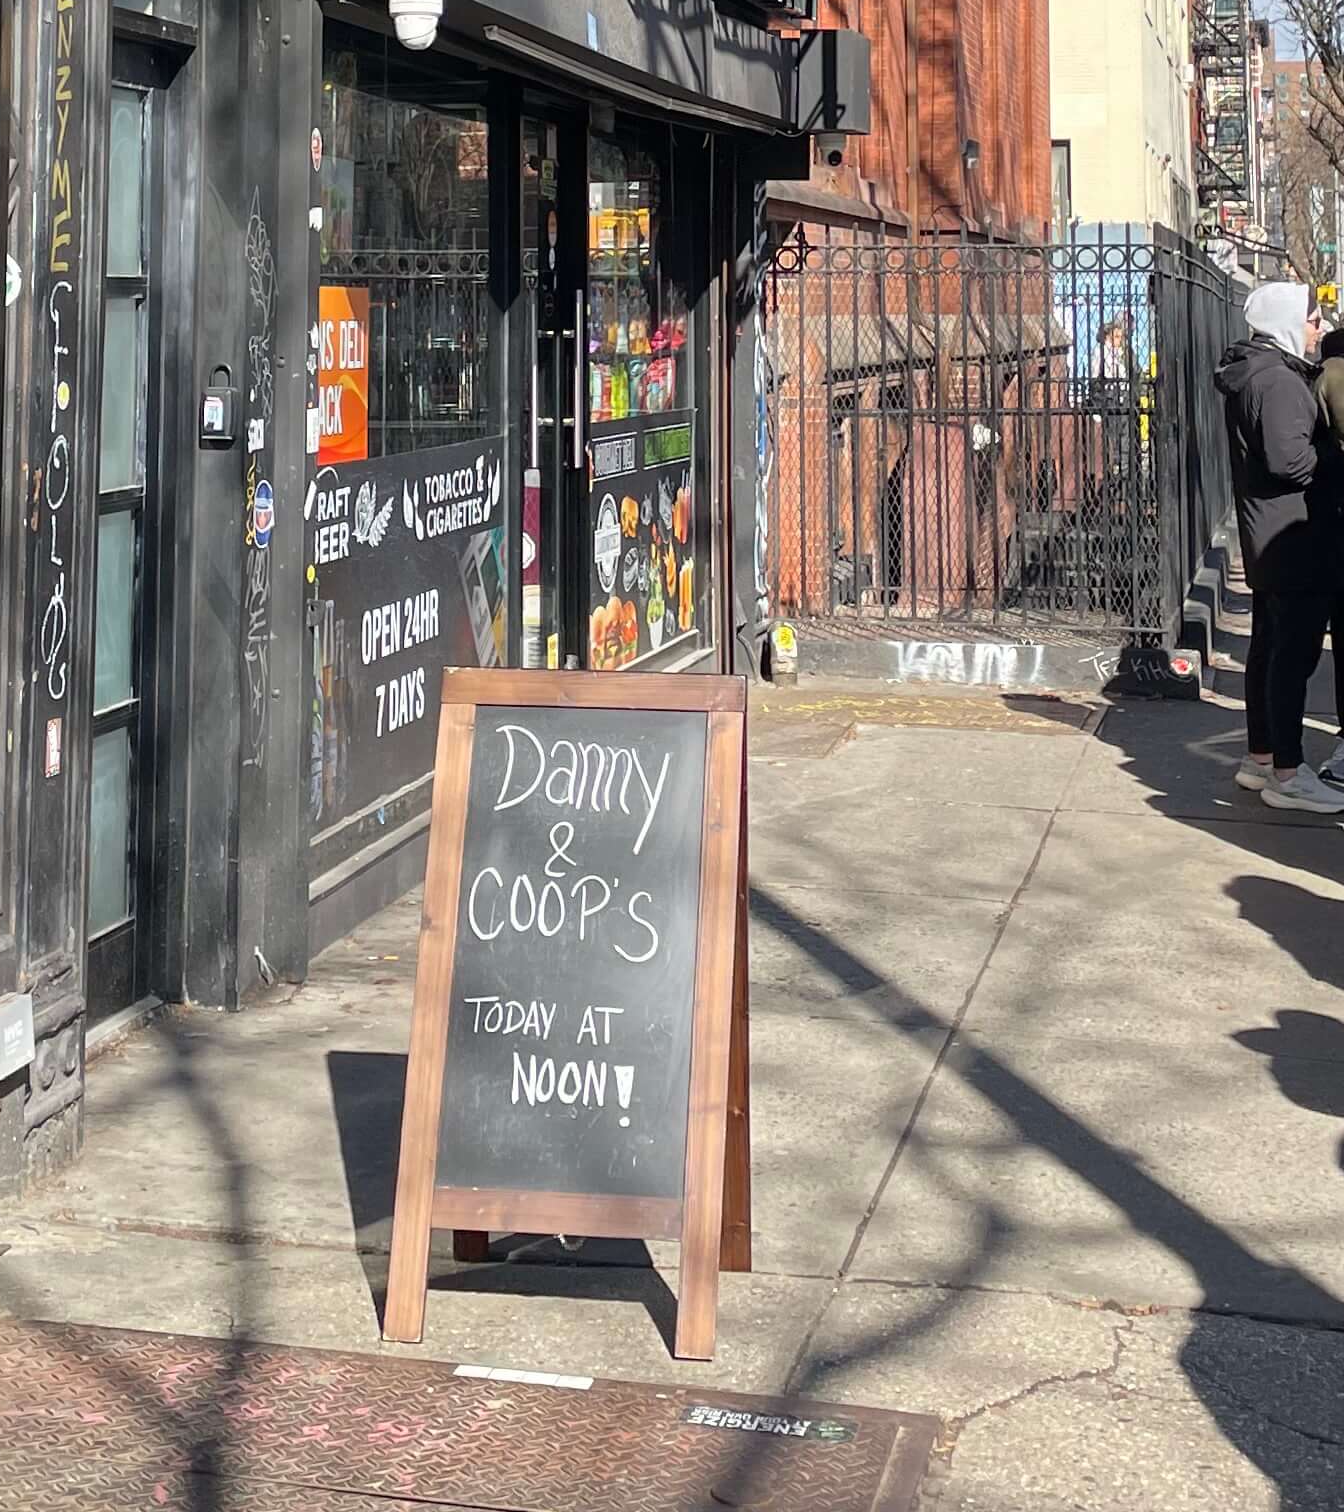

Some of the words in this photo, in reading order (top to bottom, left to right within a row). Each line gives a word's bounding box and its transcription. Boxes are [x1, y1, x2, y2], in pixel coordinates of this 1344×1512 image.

[339, 320, 364, 370] DELI
[317, 487, 351, 521] RAFT
[425, 469, 473, 504] TOBACCO
[427, 498, 482, 538] CIGARETTES
[362, 606, 400, 665] OPEN
[403, 589, 440, 649] 24HR
[374, 684, 384, 738] 7
[388, 668, 425, 731] DAYS
[493, 724, 671, 855] Danny
[544, 821, 577, 877] &
[467, 866, 660, 963] COOP'S
[464, 996, 557, 1037] TODAY
[575, 1006, 624, 1045] AT
[510, 1052, 635, 1127] NOON!
[687, 1414, 807, 1436] ENERGIZE
